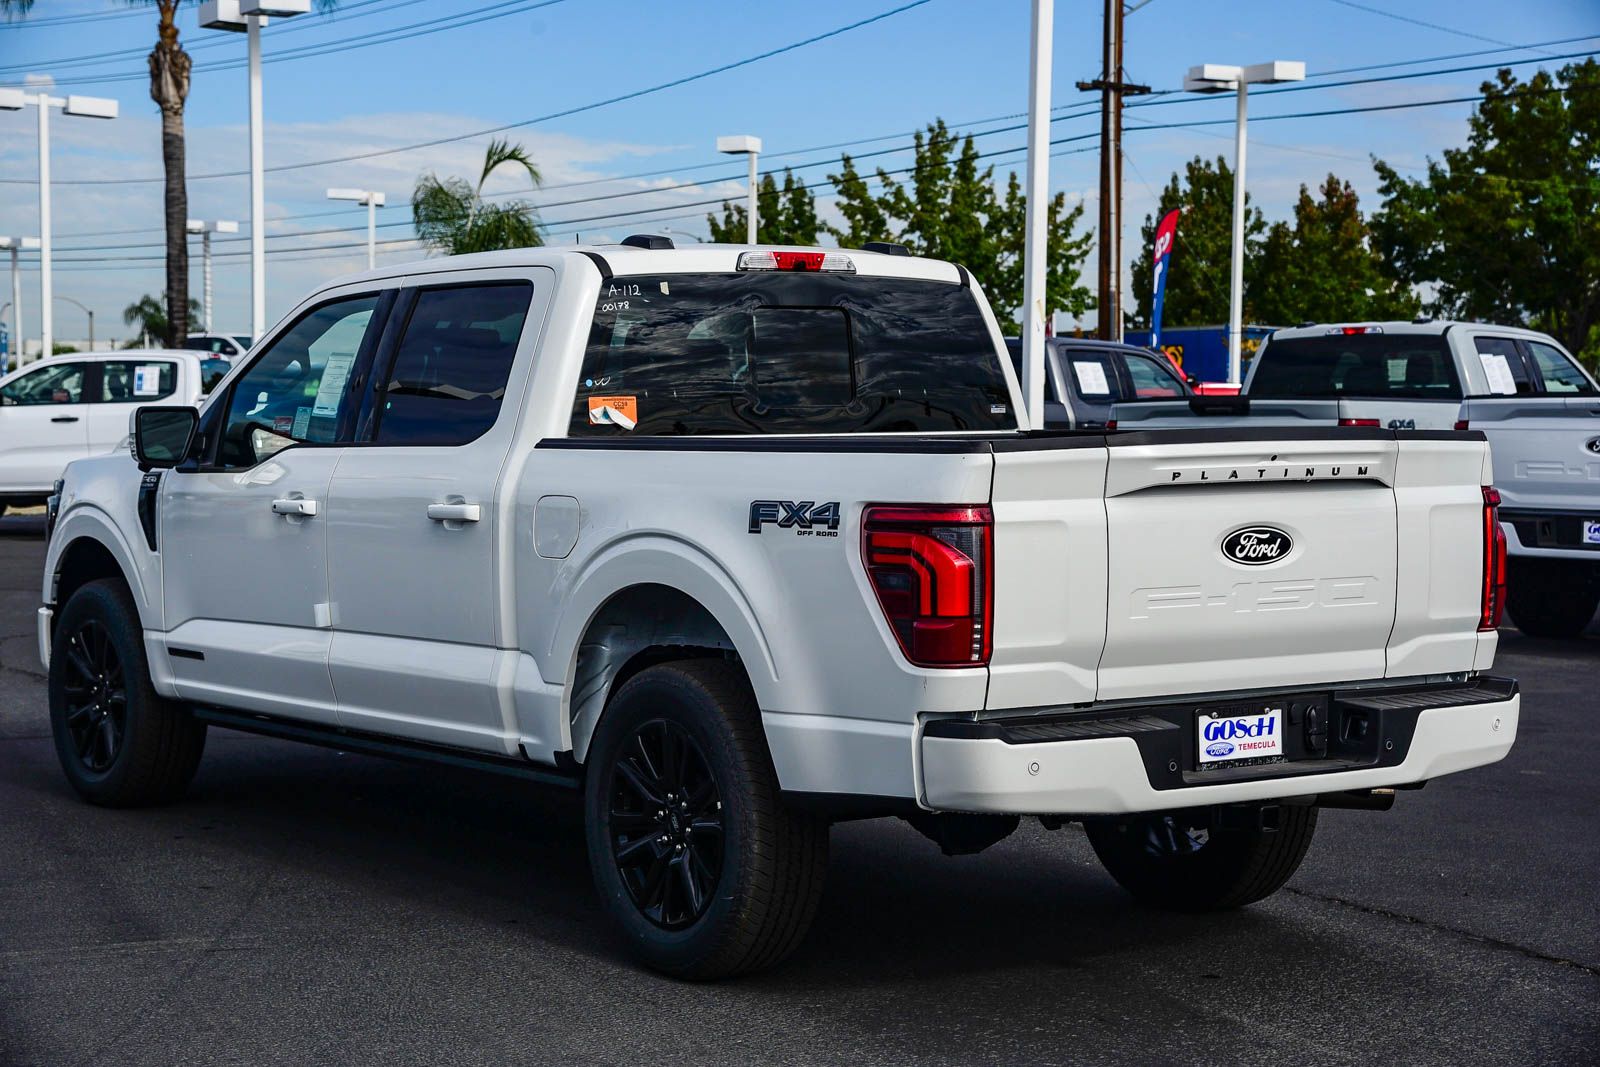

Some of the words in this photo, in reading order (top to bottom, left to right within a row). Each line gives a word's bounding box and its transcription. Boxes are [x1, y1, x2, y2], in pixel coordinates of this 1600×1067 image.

[609, 284, 642, 298] A-112
[602, 300, 630, 312] 00178
[1171, 466, 1369, 482] PLATINUM
[748, 500, 841, 534] FX4
[815, 530, 839, 538] ROAD
[1235, 532, 1282, 558] Ford
[1128, 575, 1379, 620] F-150
[1238, 741, 1276, 751] TEMECULA
